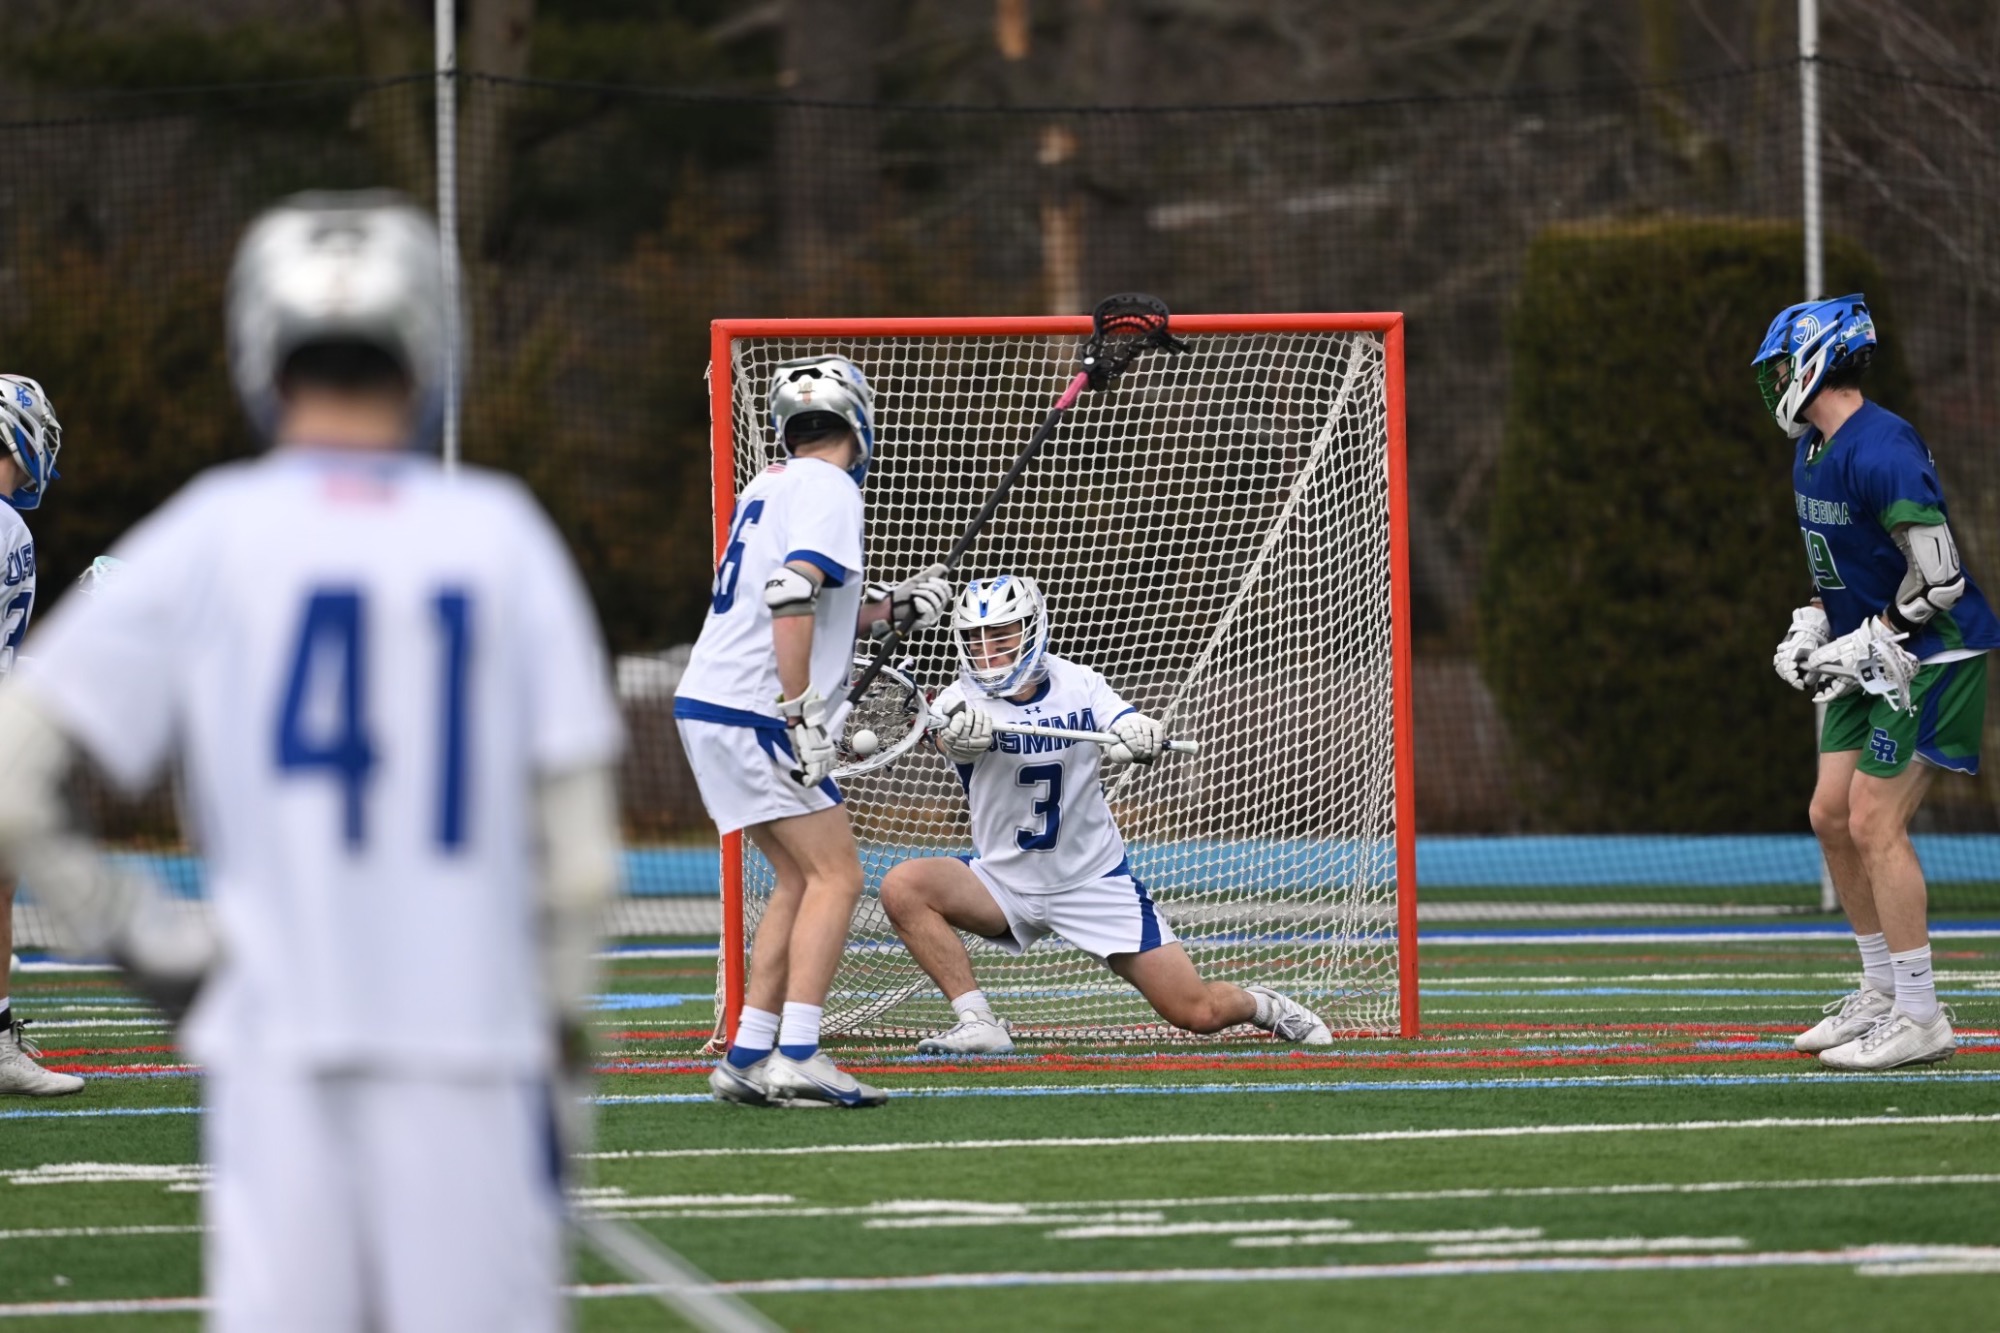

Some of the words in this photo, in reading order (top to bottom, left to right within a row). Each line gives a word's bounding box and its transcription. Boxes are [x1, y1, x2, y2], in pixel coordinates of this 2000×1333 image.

[712, 499, 765, 614] 6
[275, 583, 470, 848] 41
[1015, 761, 1065, 853] 3
